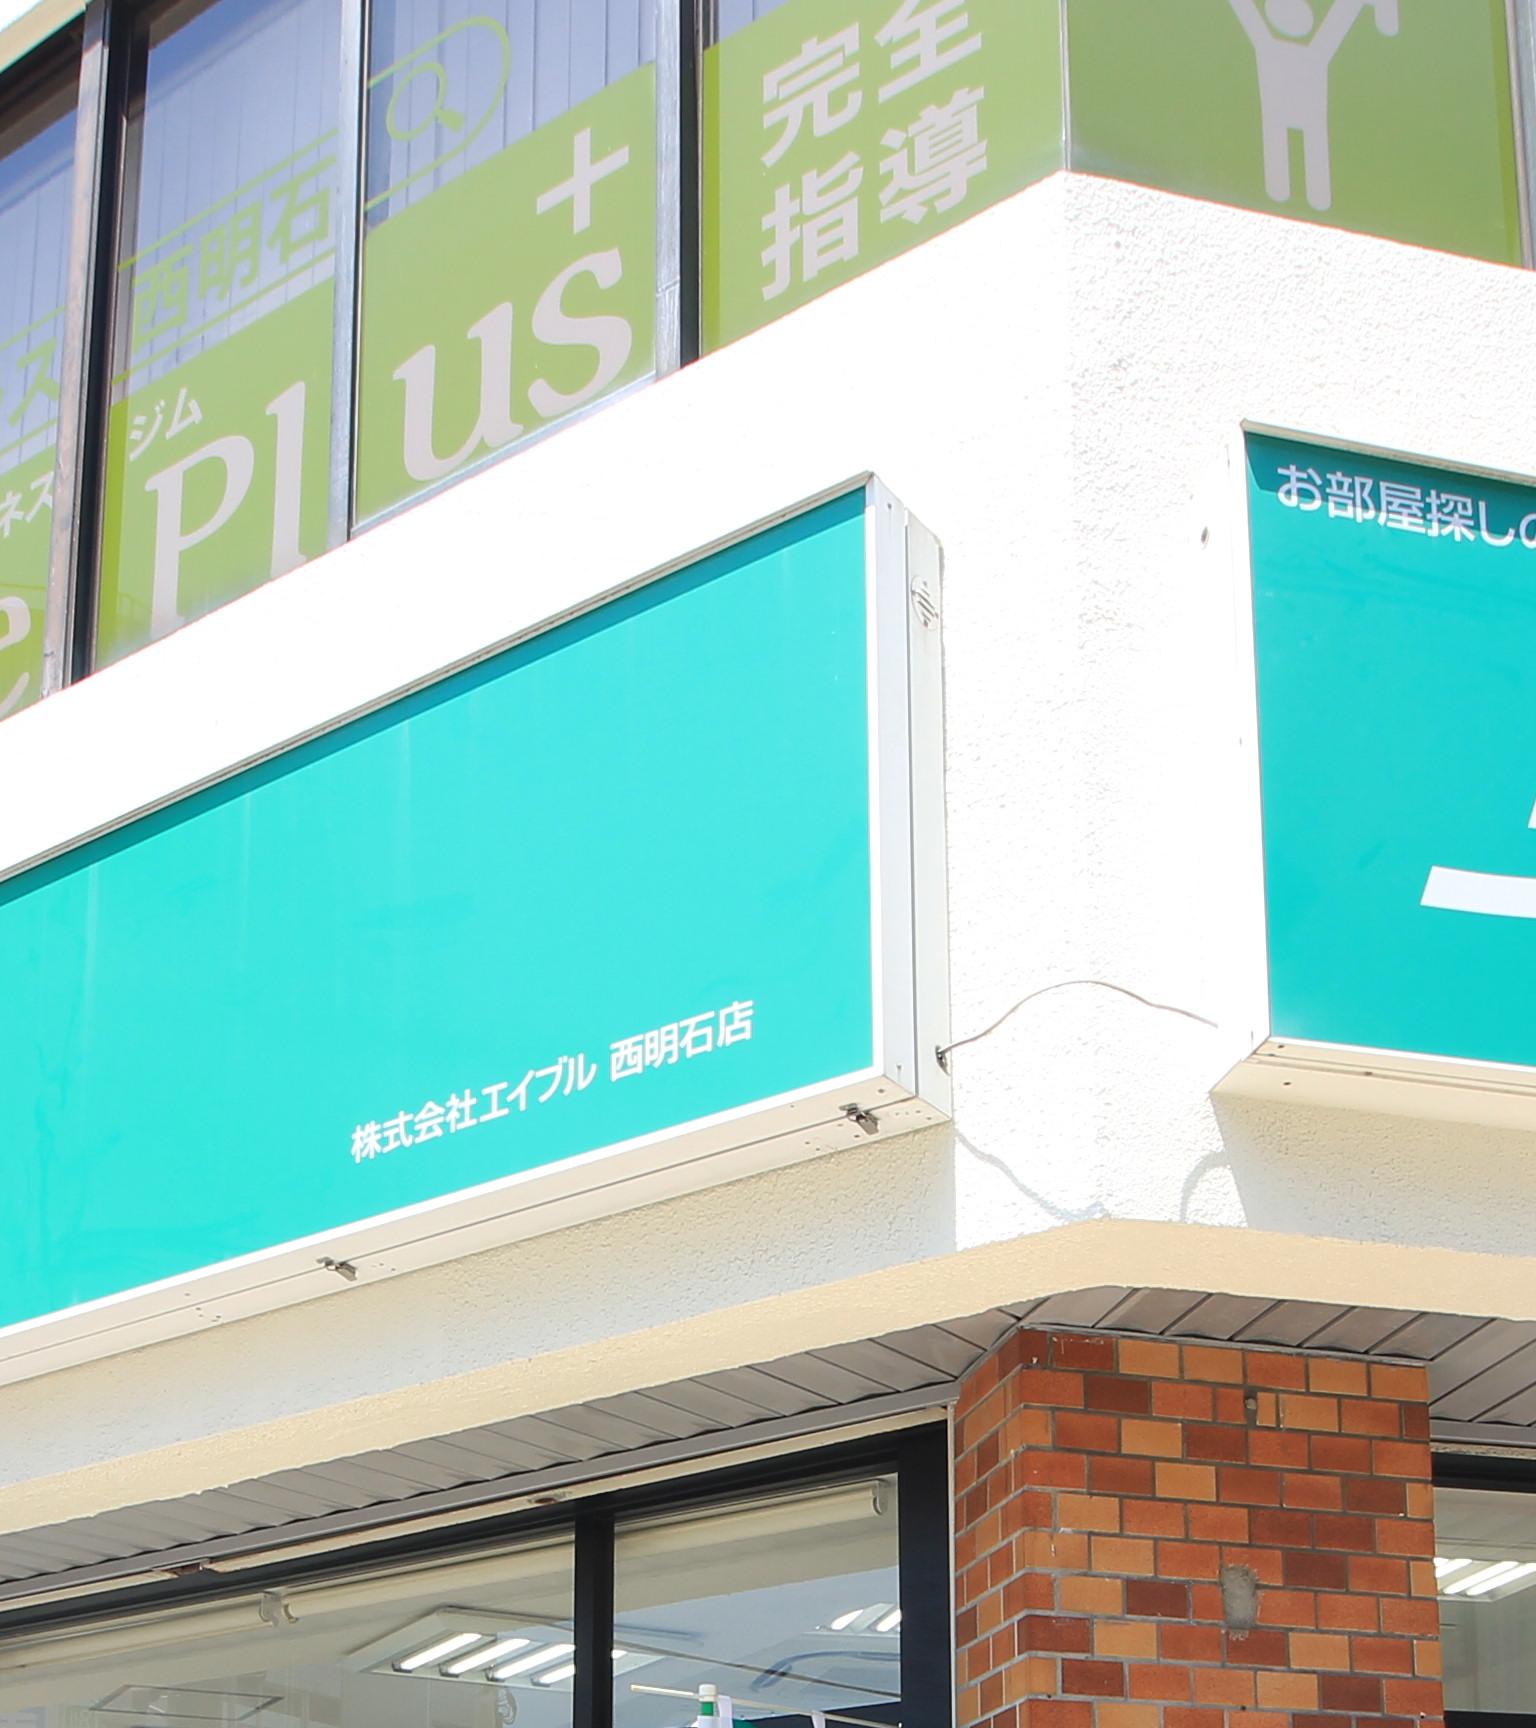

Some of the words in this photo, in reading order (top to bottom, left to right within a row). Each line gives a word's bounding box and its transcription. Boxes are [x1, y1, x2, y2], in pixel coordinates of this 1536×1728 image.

[759, 0, 985, 171] 完全
[131, 172, 338, 352] 西明石
[759, 86, 988, 303] 指導
[128, 386, 203, 463] ジム
[145, 247, 634, 639] Plus
[349, 1053, 598, 1165] 株式会社エイブル
[609, 999, 755, 1083] 西明石店
